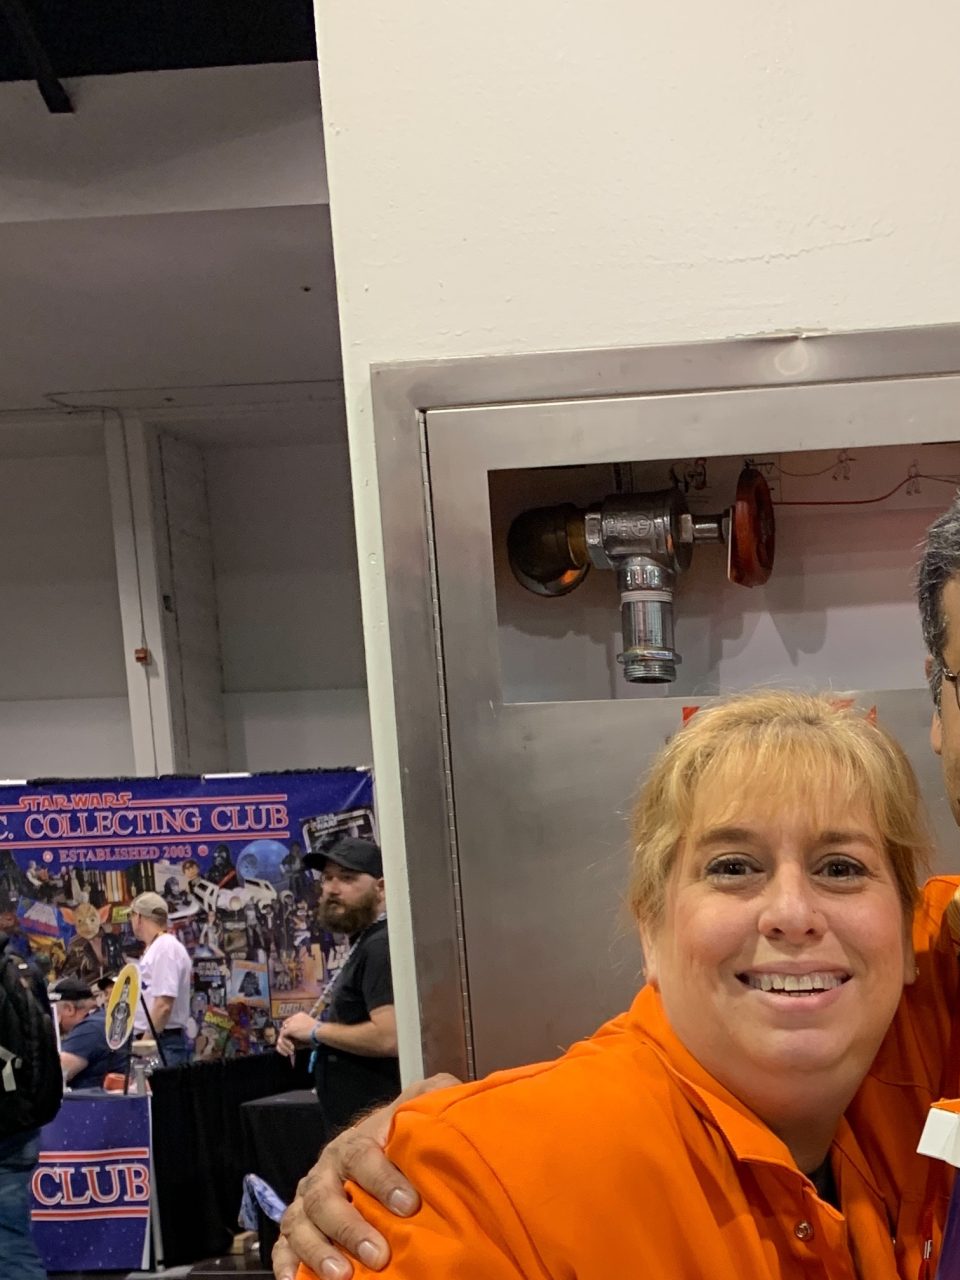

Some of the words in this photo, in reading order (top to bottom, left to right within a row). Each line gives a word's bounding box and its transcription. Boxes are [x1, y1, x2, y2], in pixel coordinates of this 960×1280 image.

[19, 795, 72, 812] STAR
[71, 792, 132, 809] WARS
[25, 808, 202, 838] COLLECTING
[211, 804, 289, 831] CLUB
[59, 847, 160, 863] ESTABLISHED
[163, 845, 192, 858] 2003
[32, 1163, 150, 1206] CLUB
